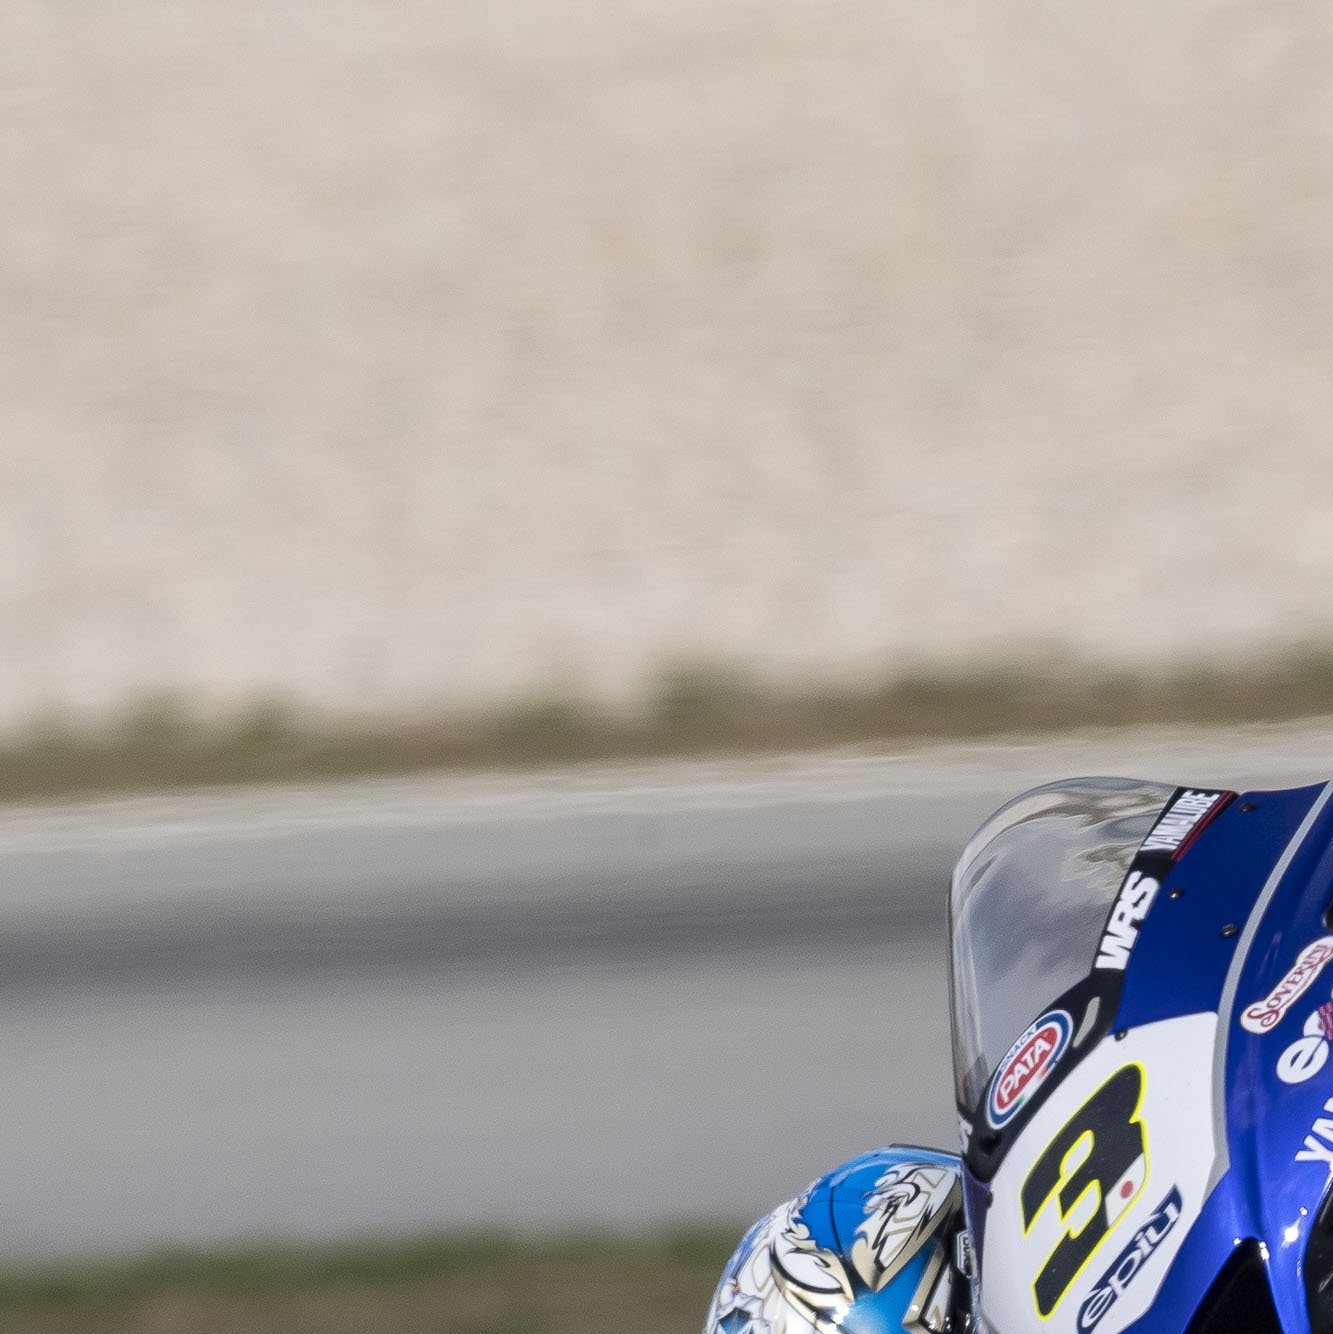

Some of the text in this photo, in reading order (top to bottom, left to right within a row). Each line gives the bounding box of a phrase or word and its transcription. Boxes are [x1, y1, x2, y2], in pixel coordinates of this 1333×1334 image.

[1095, 870, 1161, 970] WRS
[1000, 1037, 1052, 1103] PATA
[1021, 1062, 1149, 1321] 3
